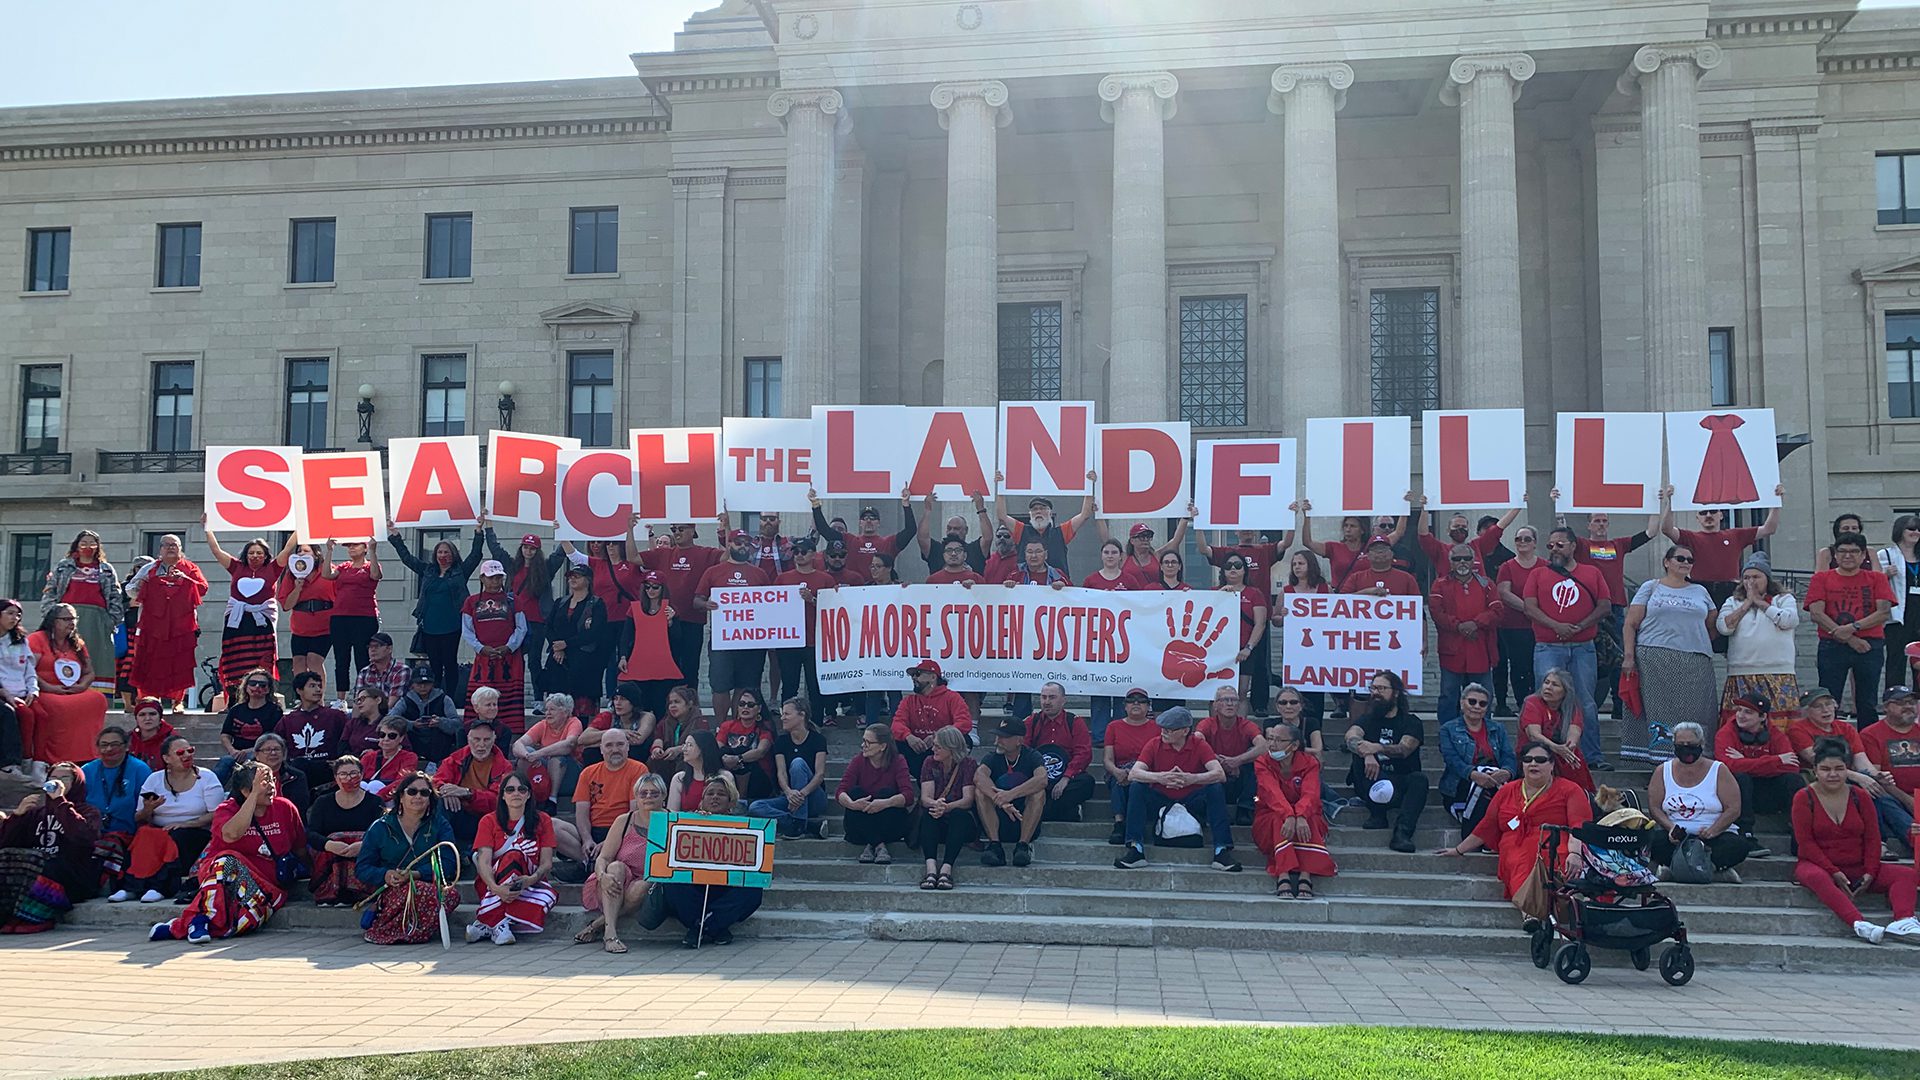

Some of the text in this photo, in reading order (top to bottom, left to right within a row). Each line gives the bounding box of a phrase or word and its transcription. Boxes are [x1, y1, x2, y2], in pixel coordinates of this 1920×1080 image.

[215, 406, 1643, 539] SEARCH THE LANDFILL
[720, 590, 788, 604] SEARCH
[723, 609, 755, 622] THE
[1291, 598, 1417, 620] SEARCH
[722, 627, 800, 641] LANDFILL
[820, 603, 1131, 664] NO MORE STOLEN SISTERS
[1322, 631, 1381, 650] THE
[820, 669, 864, 681] #MMIWG2S
[872, 668, 904, 679] Missing
[966, 670, 1010, 680] Indigenous
[1011, 670, 1045, 681] Women,
[1071, 673, 1087, 682] and
[1089, 673, 1108, 683] Two
[1110, 674, 1133, 684] Spirit
[1283, 665, 1418, 690] LANDFL
[678, 832, 754, 864] GENOCIDE
